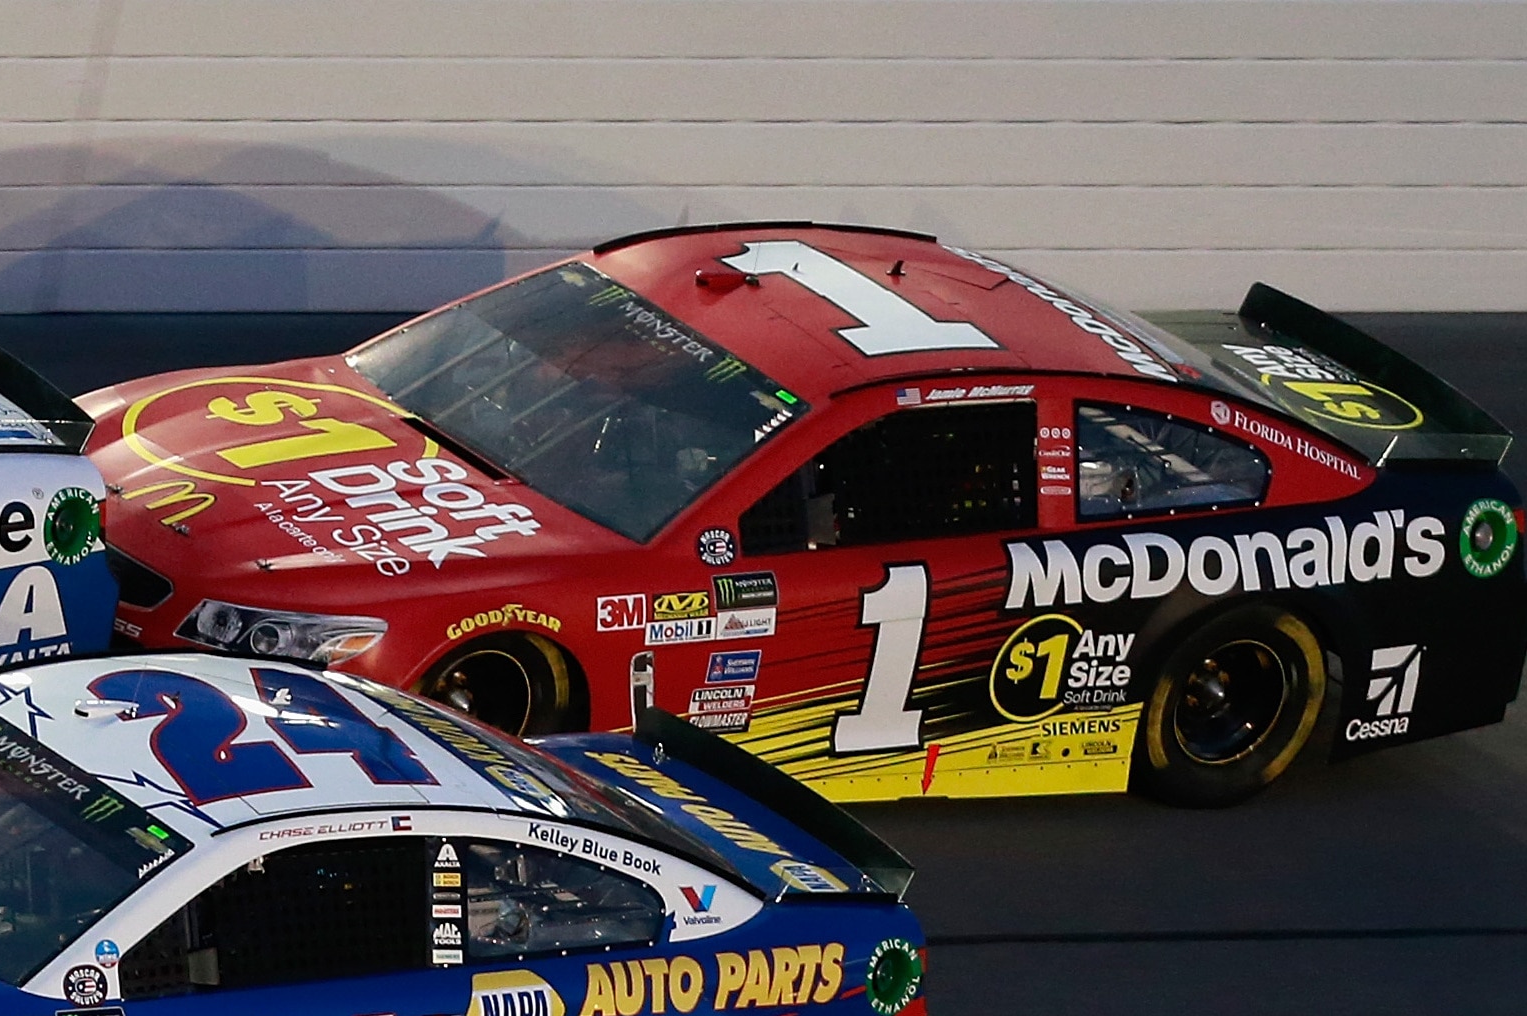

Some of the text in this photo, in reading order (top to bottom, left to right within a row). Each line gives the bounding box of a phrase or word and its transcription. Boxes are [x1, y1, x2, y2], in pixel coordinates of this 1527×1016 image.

[718, 238, 1002, 356] 1
[618, 300, 714, 362] MONSTER
[925, 385, 1035, 400] Jamie McMurray
[204, 389, 398, 470] $1
[1233, 410, 1361, 480] FLORIDA HOSPITAL
[385, 456, 543, 542] Soft
[47, 487, 99, 565] AMERICAN ETHANOL
[254, 502, 273, 511] A
[266, 508, 284, 523] la
[278, 521, 317, 547] carte
[261, 478, 411, 577] Any Size
[308, 464, 499, 570] Drink
[700, 529, 730, 543] NASCAR
[1463, 499, 1515, 576] AMERICAN ETHANOL
[701, 552, 734, 565] SALUTES
[1005, 508, 1447, 609] McDonald's
[446, 603, 561, 640] GOODYEAR
[599, 596, 643, 629] 3M
[649, 621, 693, 639] Mobil
[833, 566, 933, 752] 1
[1072, 629, 1135, 661] Any
[1006, 634, 1070, 699] $1
[1067, 659, 1131, 688] Size
[695, 688, 743, 700] LINCOLN
[703, 699, 745, 709] WELDERS
[1063, 689, 1127, 704] Soft Drink
[1042, 719, 1121, 736] SIEMENS
[1345, 716, 1410, 741] Cessna
[259, 820, 388, 840] CHASE ELLIOTT
[528, 823, 662, 875] Kelley Blue Book
[433, 923, 461, 938] MAC
[682, 916, 722, 926] Valvoline
[68, 968, 100, 983] NASCAR
[713, 941, 846, 1012] PARTS
[867, 939, 920, 1013] AMERICAN ETHANOL
[70, 992, 103, 1006] SALUTES
